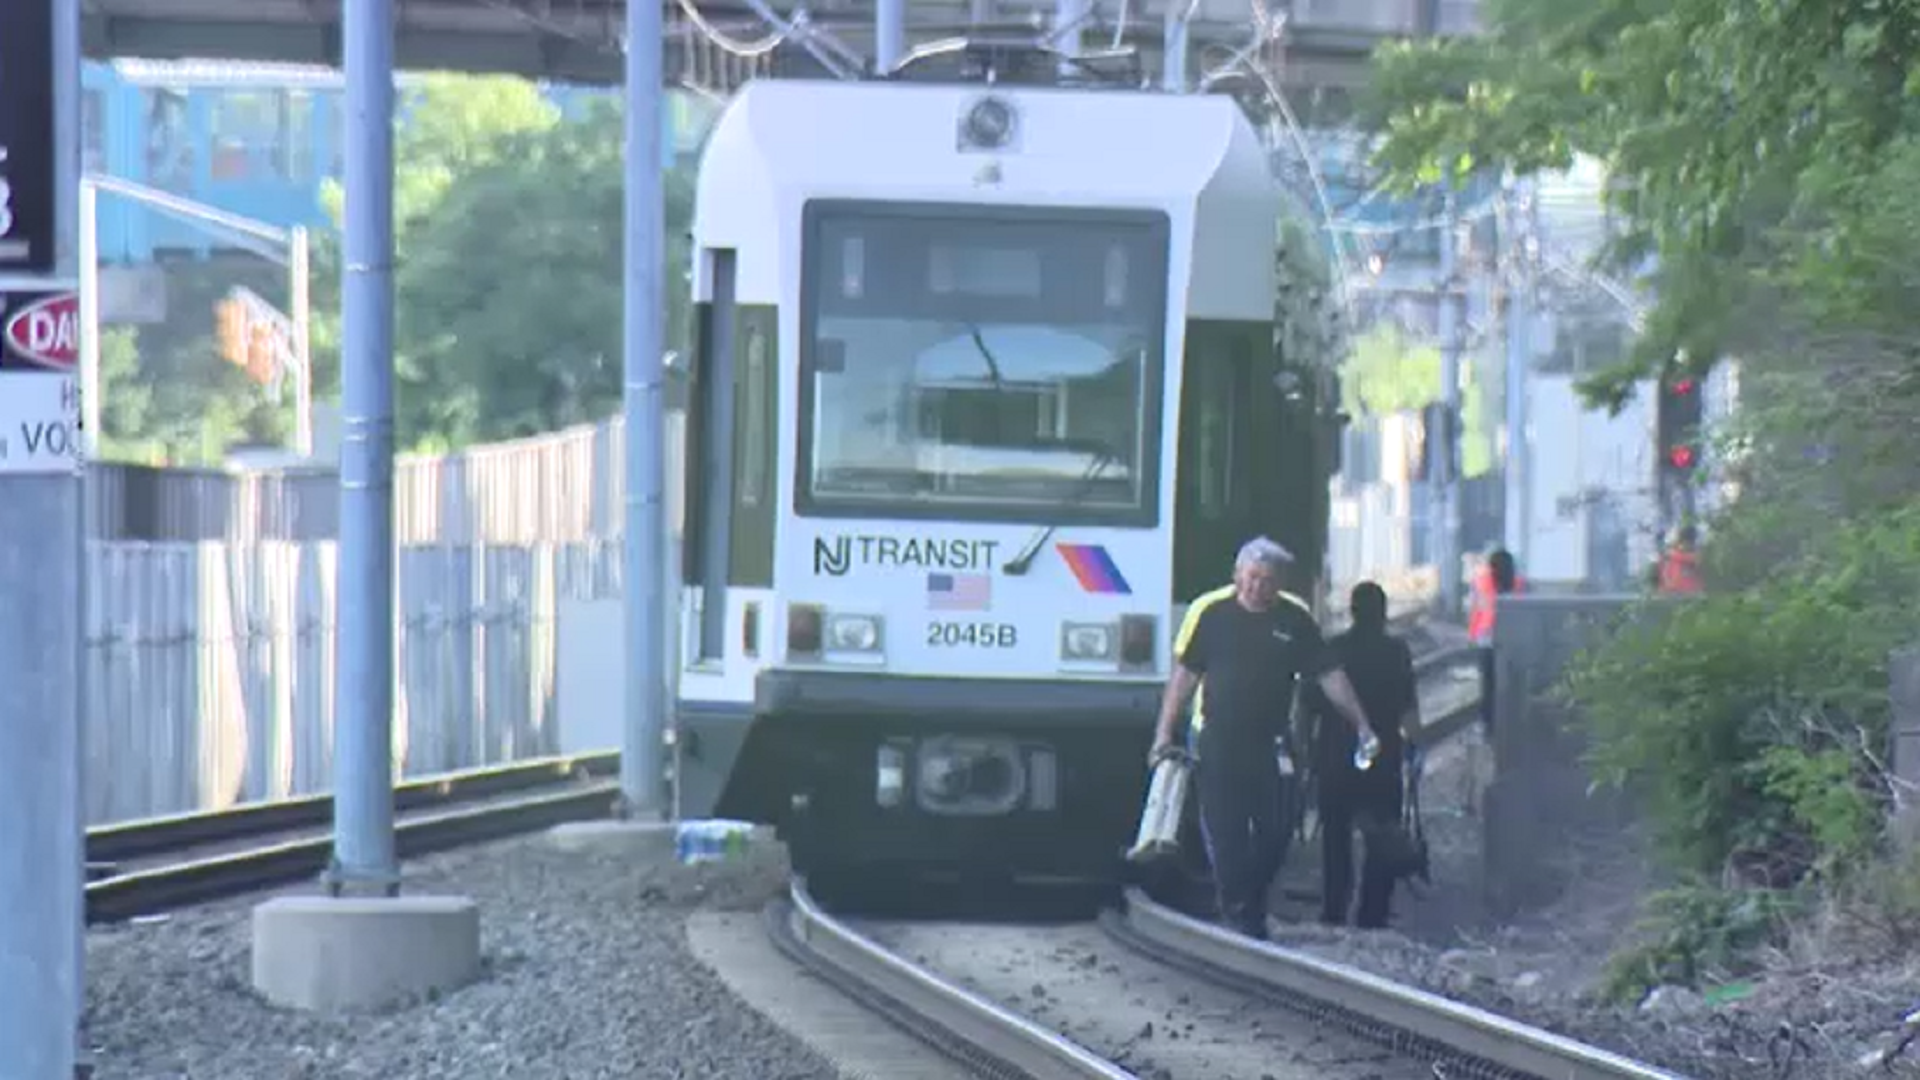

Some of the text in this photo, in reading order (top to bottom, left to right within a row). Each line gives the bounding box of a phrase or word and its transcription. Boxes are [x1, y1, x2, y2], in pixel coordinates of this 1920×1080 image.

[29, 311, 79, 351] DA
[814, 536, 998, 576] NJ TRANSIT
[926, 623, 1017, 648] 2045B
